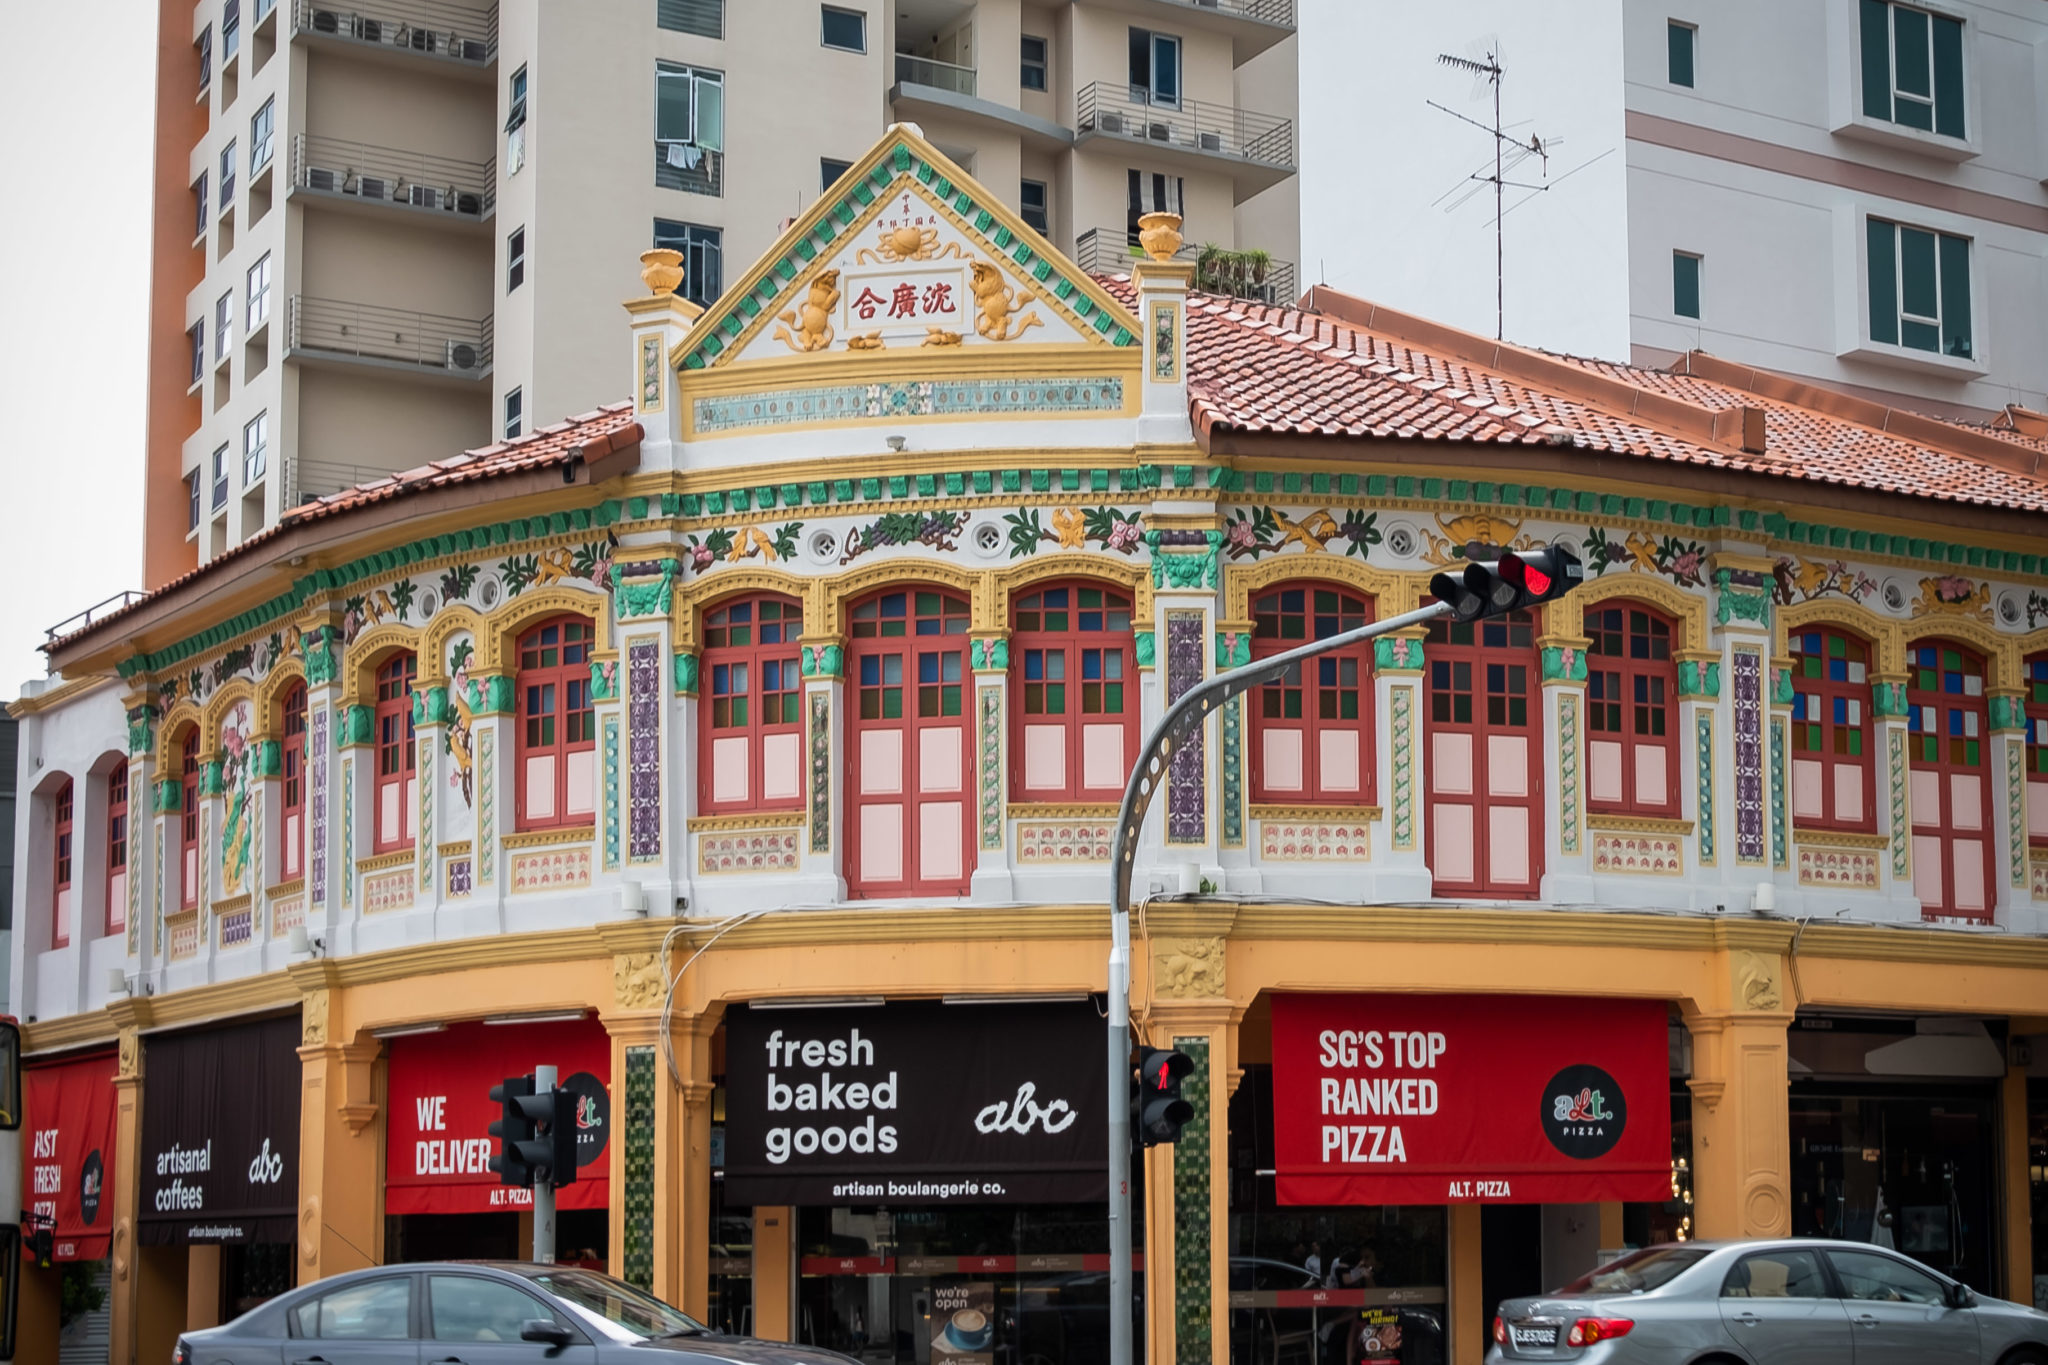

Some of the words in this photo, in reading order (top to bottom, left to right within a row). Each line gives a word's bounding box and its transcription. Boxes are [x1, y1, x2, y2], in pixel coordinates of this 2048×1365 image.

[765, 1028, 874, 1067] fresh
[1389, 1031, 1446, 1069] TOP
[767, 1071, 897, 1111] baked
[1321, 1078, 1438, 1116] RANKED
[416, 1095, 447, 1131] WE
[974, 1081, 1078, 1135] abc
[34, 1129, 59, 1159] FAST
[576, 1134, 595, 1144] ZZA
[765, 1115, 898, 1164] goods
[1322, 1125, 1407, 1163] PIZZA
[1563, 1127, 1604, 1136] PIZZA
[157, 1138, 211, 1176] artisanal
[248, 1137, 283, 1184] abc
[416, 1138, 492, 1175] DELIVER
[34, 1165, 61, 1194] FRESH
[832, 1180, 884, 1196] artisan
[888, 1179, 979, 1199] boulangerie
[982, 1183, 1006, 1195] co.
[1121, 1181, 1128, 1195] 3
[1448, 1181, 1474, 1198] ALT.
[1476, 1180, 1511, 1197] PIZZA
[155, 1178, 203, 1212] coffees
[490, 1189, 507, 1205] ALT.
[508, 1188, 533, 1204] PIZZA
[188, 1224, 204, 1238] artisan
[205, 1224, 234, 1240] boulangerie
[235, 1226, 243, 1237] co.
[935, 1286, 969, 1298] we're
[935, 1298, 968, 1311] open
[1361, 1309, 1383, 1319] WE'RE
[1370, 1314, 1398, 1325] HIRING!
